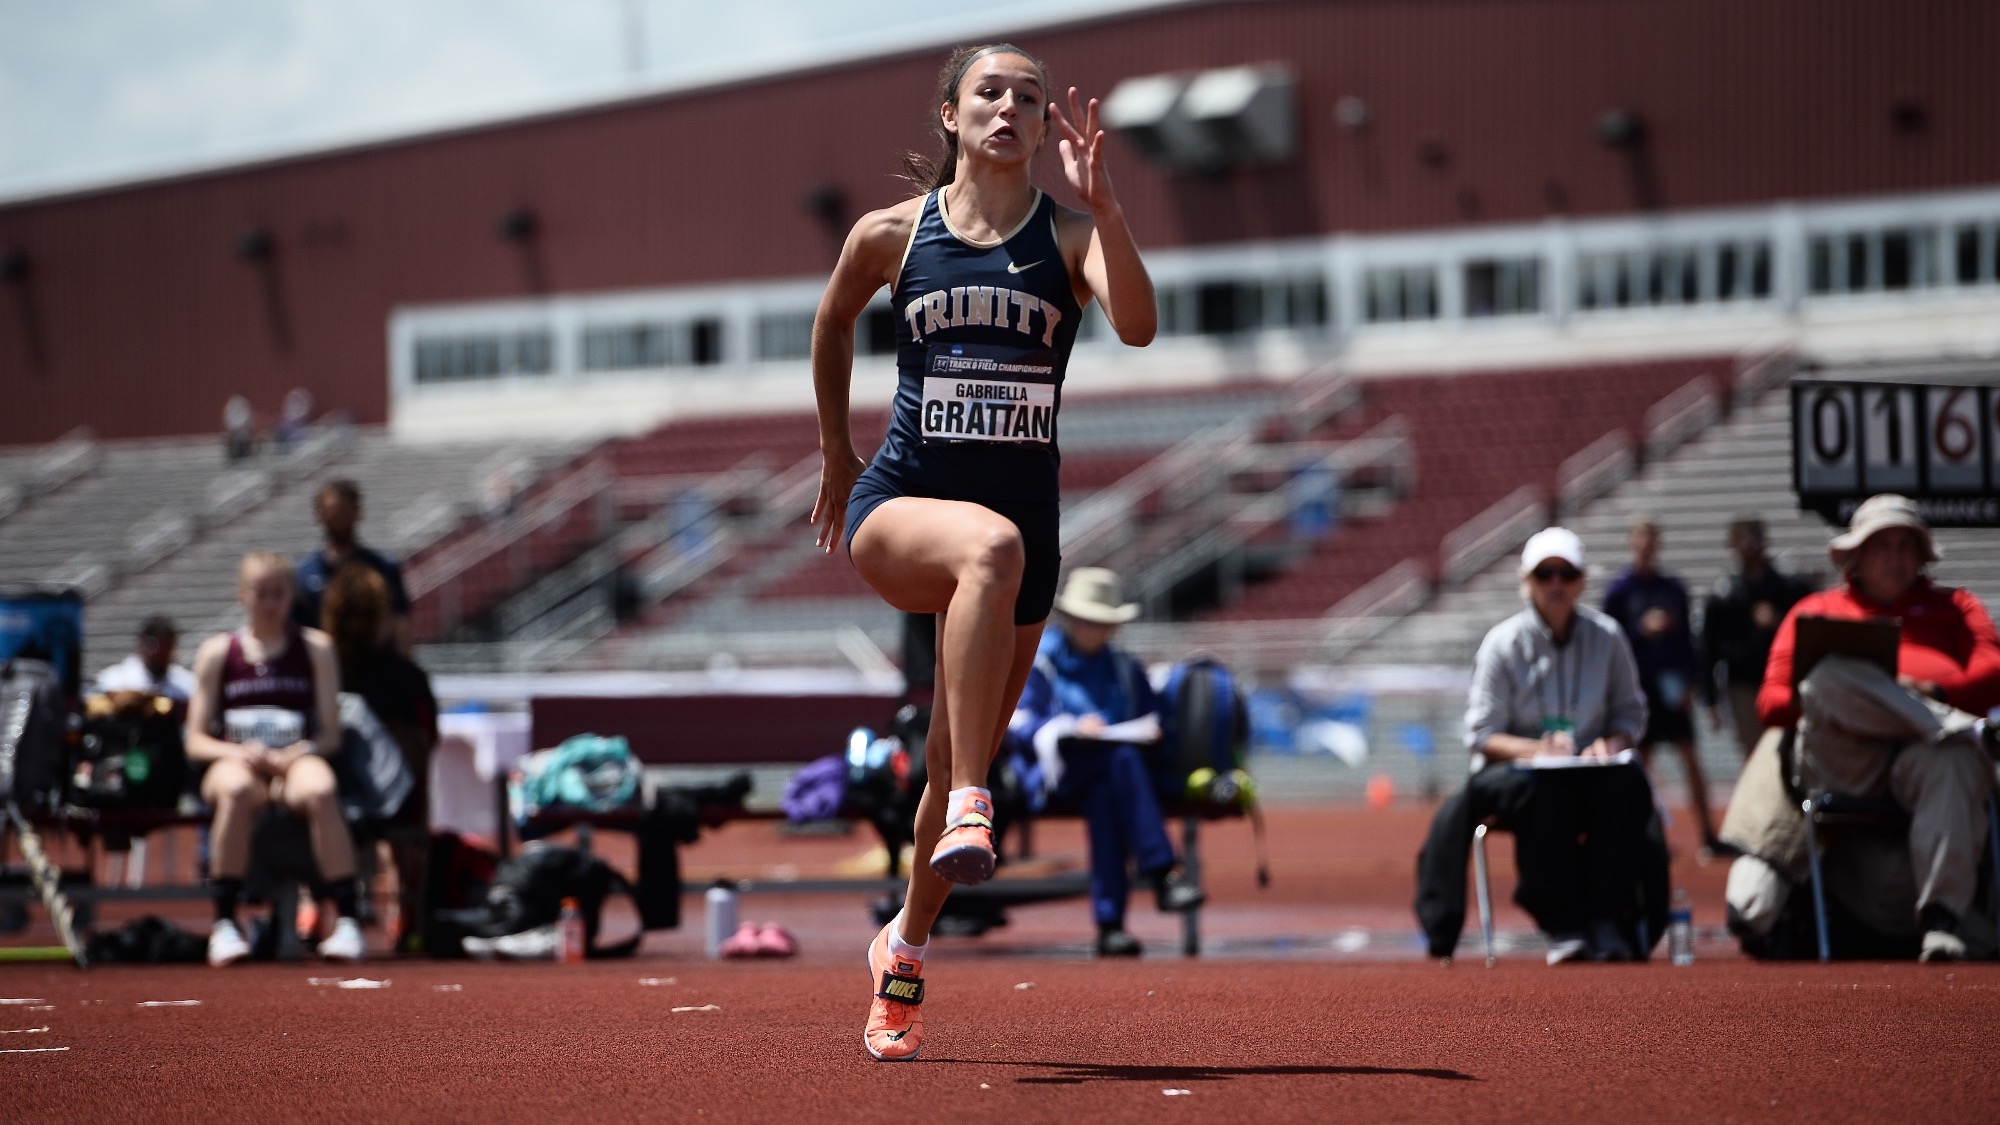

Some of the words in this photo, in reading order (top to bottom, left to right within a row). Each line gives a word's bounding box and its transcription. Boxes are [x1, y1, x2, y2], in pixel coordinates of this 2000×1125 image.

[905, 286, 1061, 347] TRINITY
[950, 360, 972, 369] TRACK
[978, 361, 998, 371] FIELD
[998, 363, 1053, 374] CHAMPIONSHIPS
[956, 383, 1028, 401] GABRIELLA
[925, 399, 1052, 439] GRATTAN
[1812, 385, 2000, 467] 016
[885, 979, 918, 999] NIKE
